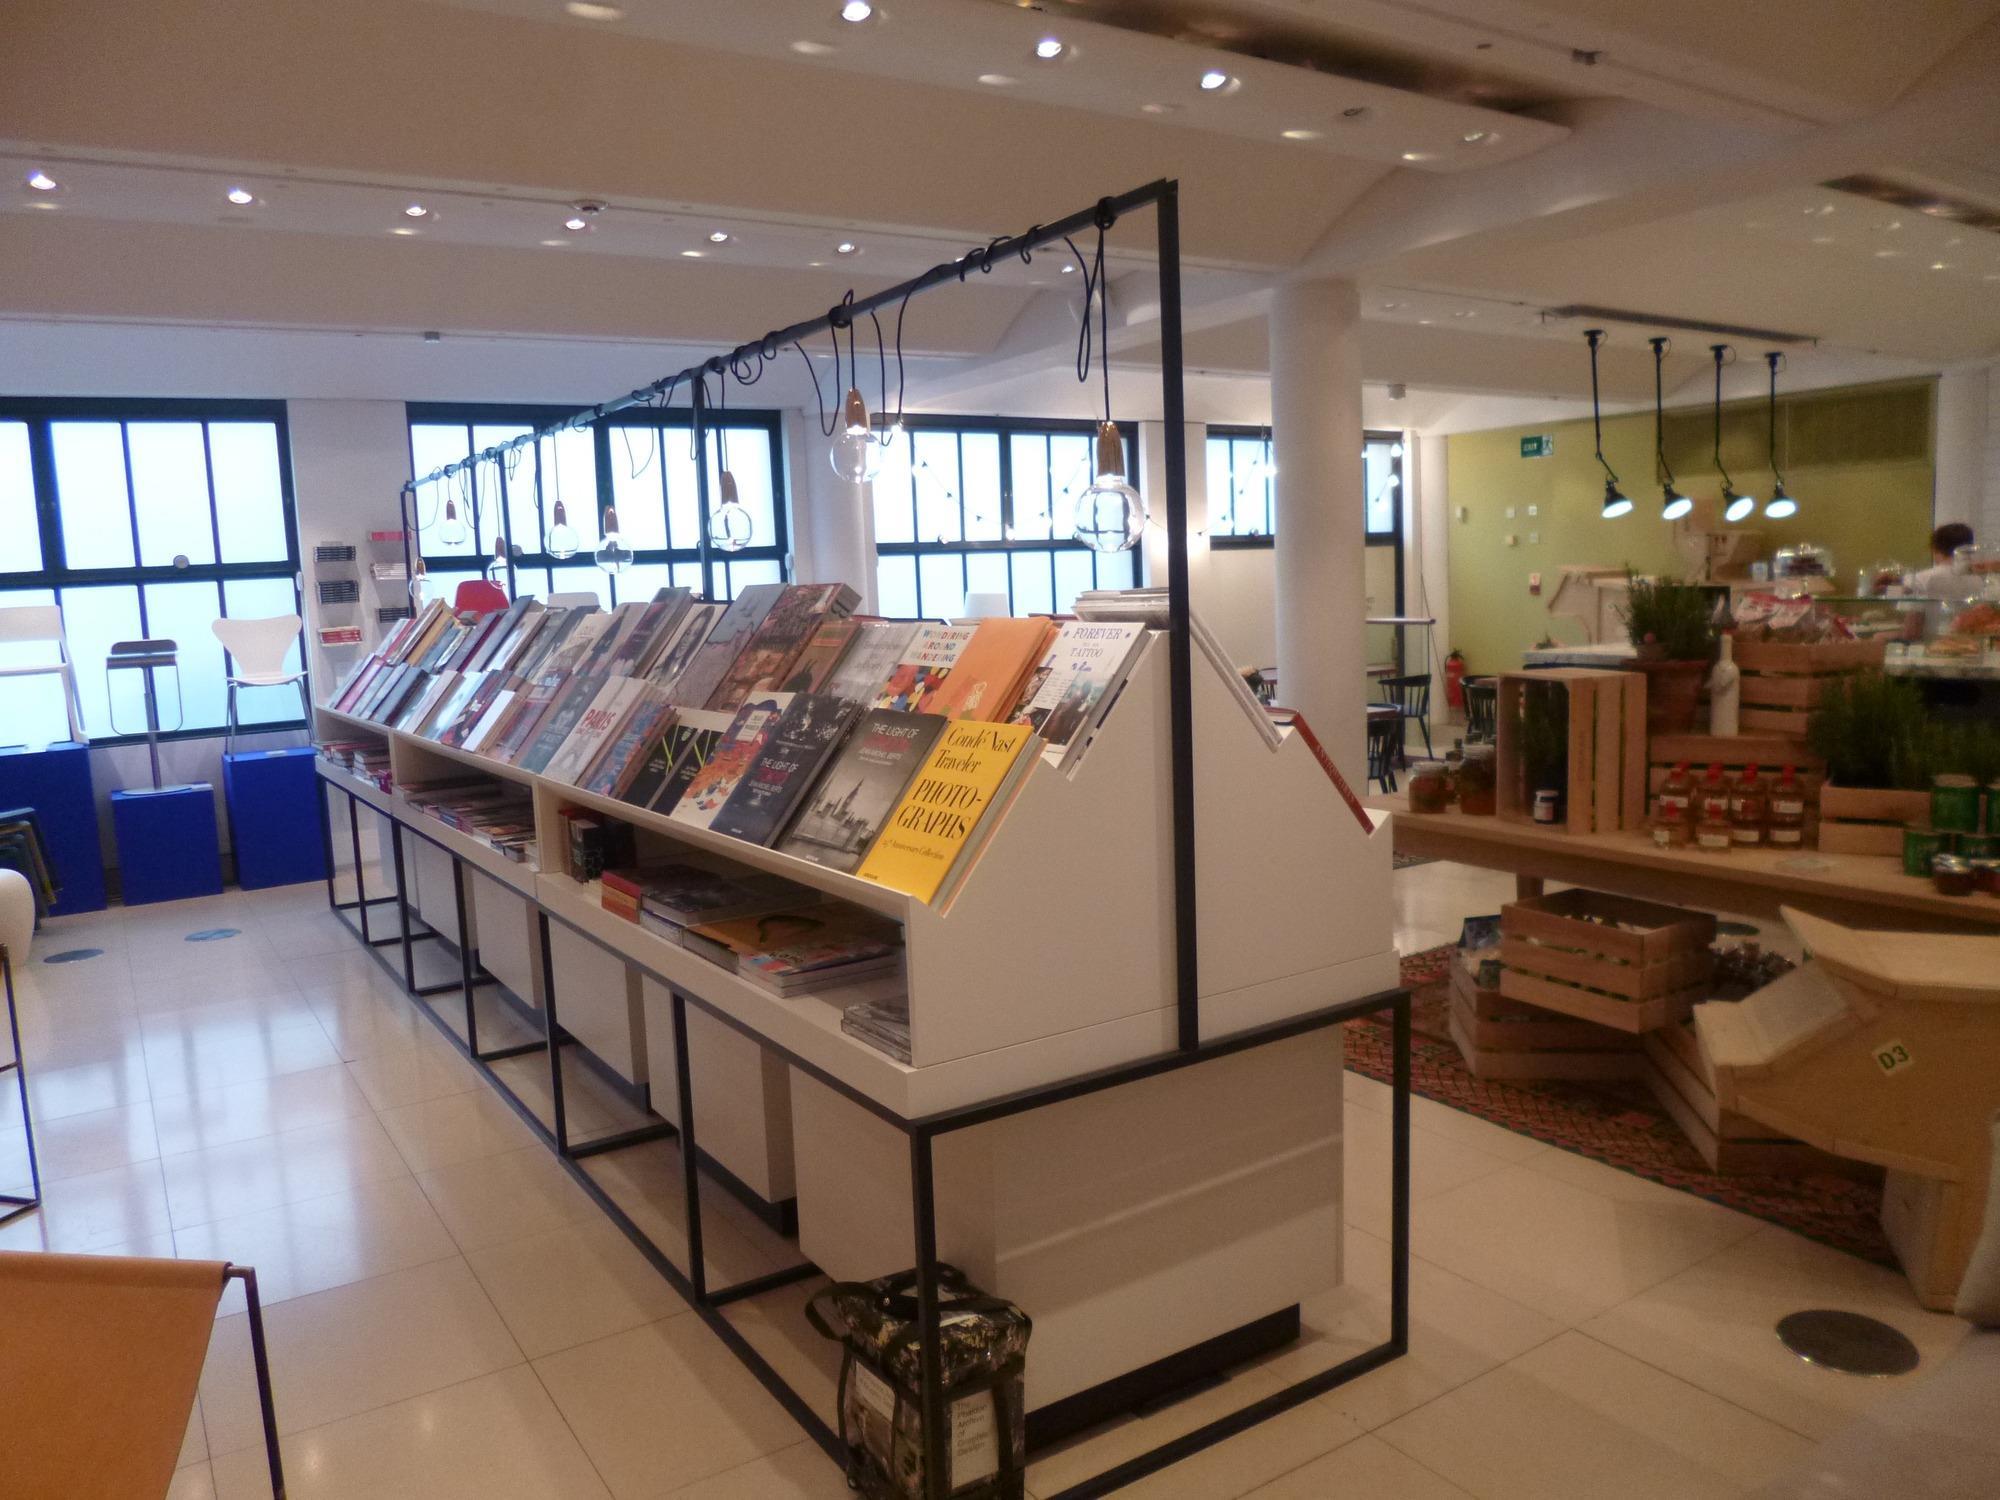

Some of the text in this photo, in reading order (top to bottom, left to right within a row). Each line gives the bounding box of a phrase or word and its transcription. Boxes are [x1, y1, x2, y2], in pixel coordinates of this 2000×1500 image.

[1073, 627, 1123, 640] FOREVER
[923, 642, 957, 651] ROND
[1070, 647, 1104, 658] TATTOO
[582, 708, 617, 731] PARIS
[907, 728, 920, 739] OF
[946, 727, 1017, 753] Condé Nast
[932, 749, 982, 774] Traveler
[912, 778, 983, 810] PHOTO-
[897, 805, 972, 840] GRAPHS
[1878, 1045, 1909, 1070] D3
